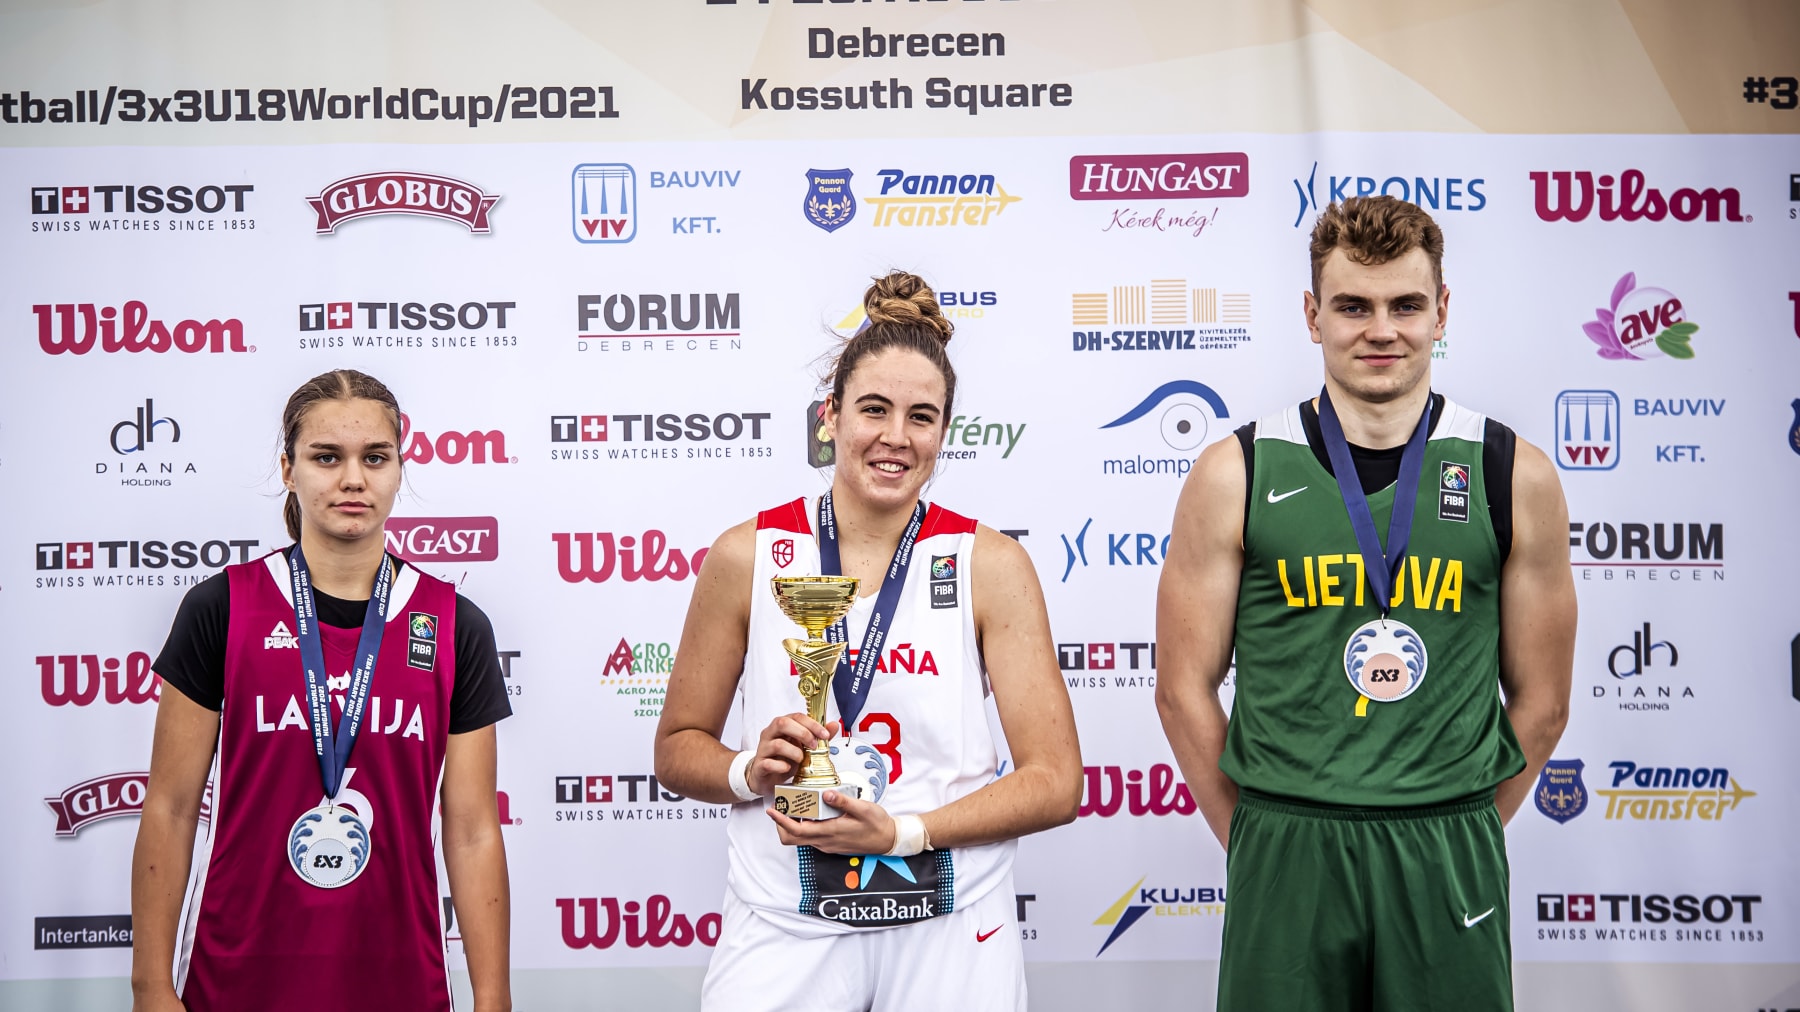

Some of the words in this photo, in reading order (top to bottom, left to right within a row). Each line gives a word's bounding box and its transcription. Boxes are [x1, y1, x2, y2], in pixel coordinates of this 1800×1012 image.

[808, 27, 1005, 58] Debrecen
[741, 78, 912, 110] Kossuth
[926, 77, 1072, 115] Square
[1743, 77, 1799, 110] #3
[651, 170, 741, 188] BAUVIV
[814, 176, 846, 186] Pannon
[877, 169, 996, 196] Pannon
[94, 185, 254, 213] TISSOT
[327, 178, 473, 216] GLOBUS
[1529, 169, 1744, 222] Wilson
[864, 195, 999, 227] Transfer
[1102, 207, 1166, 232] Kérek
[1167, 207, 1219, 237] még!
[32, 221, 80, 232] SWISS
[89, 220, 159, 230] WATCHES
[170, 220, 214, 230] SINCE
[224, 220, 255, 229] 1853
[582, 219, 627, 238] VIV
[673, 217, 721, 234] KFT.
[940, 291, 997, 306] BUS
[358, 302, 516, 330] TISSOT
[578, 293, 740, 334] FORUM
[1620, 298, 1683, 346] ave
[32, 300, 248, 355] Wilson
[300, 337, 343, 349] SWISS
[353, 336, 422, 347] WATCHES
[432, 337, 476, 347] SINCE
[486, 336, 516, 346] 1853
[578, 337, 740, 351] DEBRECEN
[1635, 399, 1726, 416] BAUVIV
[401, 412, 509, 465] son
[613, 413, 771, 441] TISSOT
[552, 449, 598, 460] SWISS
[608, 448, 677, 459] WATCHES
[688, 448, 731, 458] SINCE
[741, 447, 771, 457] 1853
[937, 450, 977, 460] recen
[1565, 446, 1611, 465] VIV
[1657, 445, 1705, 462] KFT.
[96, 463, 196, 473] DIANA
[1103, 455, 1197, 478] malomp
[1444, 495, 1465, 507] FIBA
[384, 525, 490, 555] NGAST
[552, 530, 710, 583] Wils
[36, 577, 84, 588] SWISS
[93, 575, 163, 586] WATCHES
[174, 574, 210, 586] SIN
[1583, 569, 1724, 581] EBRECEN
[935, 585, 953, 595] FIBA
[303, 588, 312, 617] HUNGARY
[264, 637, 299, 650] PEAK
[412, 642, 432, 656] FIBA
[851, 677, 861, 694] FIBA
[865, 627, 876, 649] WORLD
[873, 612, 882, 627] CUP
[863, 647, 878, 679] HUNGARY
[874, 630, 883, 648] 2021
[602, 653, 674, 676] MARKE
[36, 651, 163, 706] Wil
[351, 669, 362, 699] HUNGARY
[1066, 677, 1105, 690] WISS
[1115, 677, 1155, 688] WATC
[507, 685, 522, 696] 53
[617, 687, 646, 695] AGRO
[1593, 686, 1694, 697] DIANA
[256, 694, 425, 742] LAIJA
[346, 700, 355, 716] 2021
[353, 698, 363, 721] WORLD
[321, 704, 329, 736] HUNGARY
[1546, 767, 1577, 776] Pannon
[1609, 761, 1729, 788] Pannon
[72, 780, 146, 816] GLO
[1078, 763, 1198, 818] Wils
[556, 810, 603, 821] SWISS
[613, 809, 683, 820] WATCHES
[693, 808, 727, 819] SINC
[1595, 788, 1732, 821] Transfer
[1141, 887, 1226, 904] KUJB
[819, 896, 934, 922] CaixaBank
[1155, 905, 1225, 917] ELEKT
[1600, 894, 1762, 924] TISSOT
[556, 895, 722, 949] Wilso
[1022, 930, 1037, 940] 53
[1538, 929, 1586, 940] SWISS
[1595, 929, 1666, 941] WATCHES
[1676, 929, 1721, 941] SINCE
[1731, 930, 1763, 942] 1853
